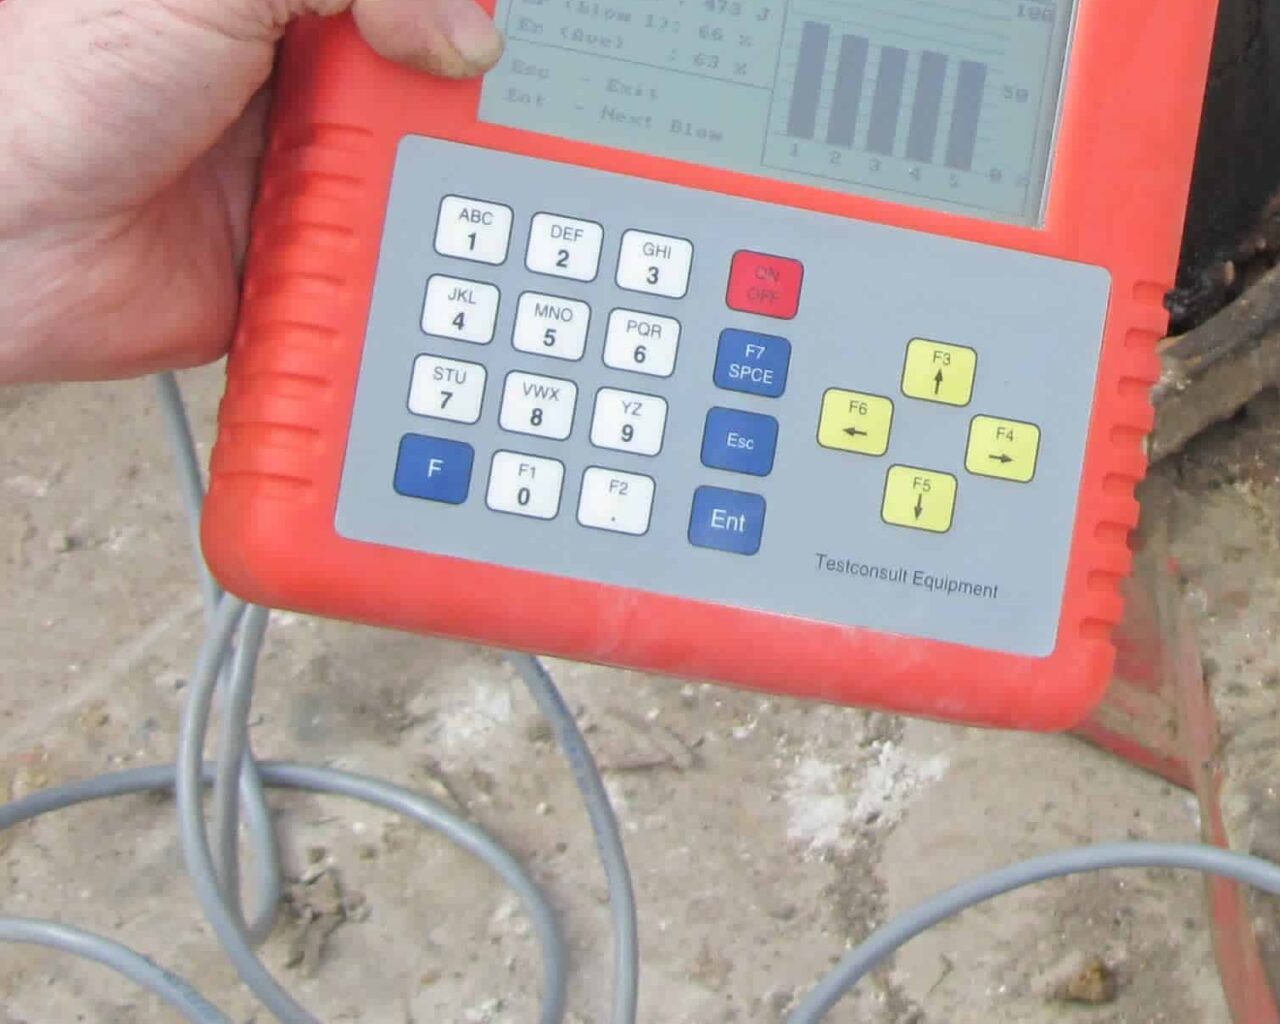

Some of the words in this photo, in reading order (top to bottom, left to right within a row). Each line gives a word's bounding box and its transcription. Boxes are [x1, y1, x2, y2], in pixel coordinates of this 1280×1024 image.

[756, 8, 770, 22] J
[605, 78, 659, 100] Exit
[601, 105, 652, 129] Next
[670, 119, 723, 142] Blow
[789, 142, 799, 157] 1
[830, 150, 842, 165] 2
[459, 208, 494, 226] ABC
[467, 233, 477, 251] 1
[550, 225, 585, 243] DEF
[556, 250, 570, 268] 2
[642, 242, 673, 260] GHI
[647, 266, 659, 285] 3
[447, 287, 477, 305] JKL
[452, 312, 466, 331] 4
[534, 302, 574, 322] MNO
[543, 328, 557, 347] 5
[626, 320, 662, 339] PQR
[634, 345, 647, 364] 6
[745, 344, 766, 361] F7
[932, 350, 951, 366] F3
[432, 366, 468, 384] STU
[728, 363, 774, 385] SPCE
[440, 391, 453, 409] 7
[523, 382, 561, 401] VWX
[530, 407, 544, 426] 8
[621, 401, 643, 417] YZ
[849, 400, 868, 415] F6
[621, 424, 634, 443] 9
[726, 432, 755, 451] Esc
[996, 426, 1015, 442] F4
[428, 458, 445, 478] F
[518, 463, 537, 479] F1
[608, 479, 629, 496] F2
[912, 477, 932, 492] F5
[517, 487, 531, 506] 0
[710, 508, 747, 533] Ent
[816, 552, 908, 583] Testconsult
[912, 570, 999, 599] Equipment
